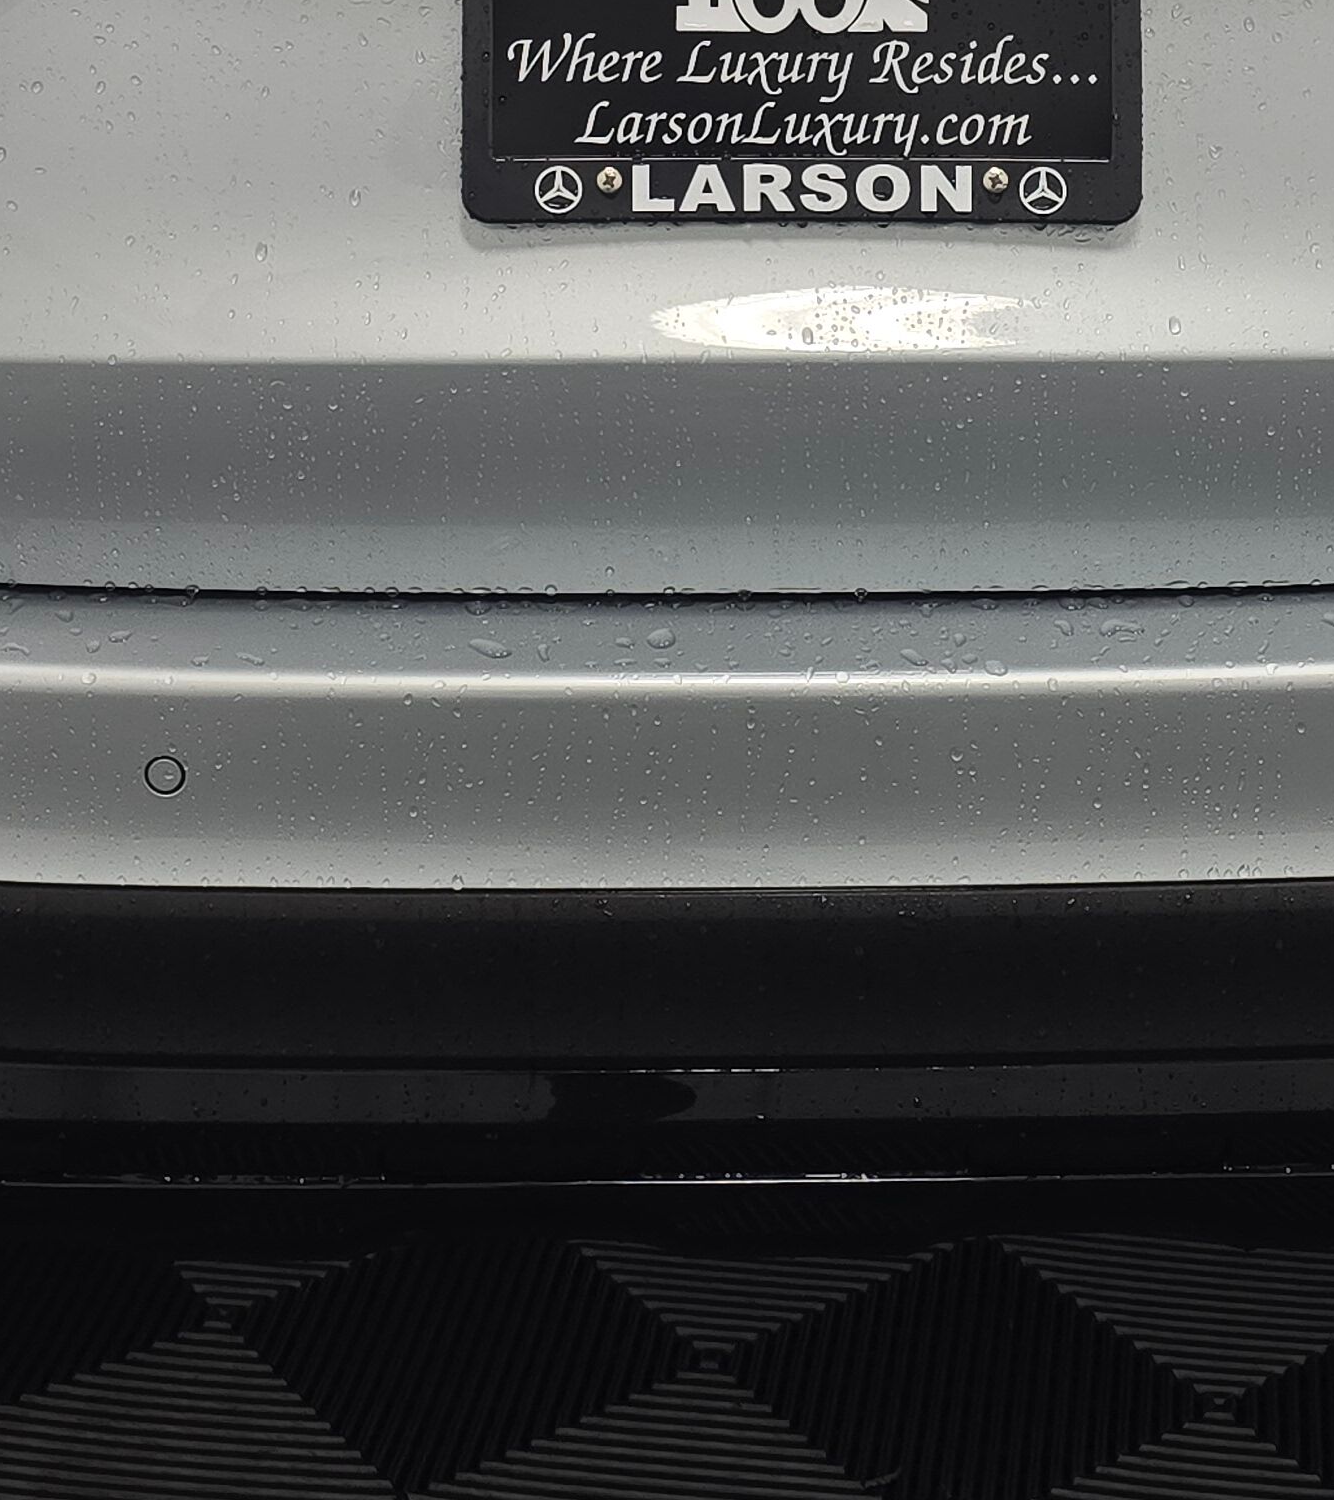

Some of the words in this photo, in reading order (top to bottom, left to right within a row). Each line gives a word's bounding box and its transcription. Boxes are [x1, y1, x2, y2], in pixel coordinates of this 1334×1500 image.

[507, 32, 663, 83] Where
[676, 40, 854, 103] Luxury
[868, 34, 1099, 94] Resides...
[573, 100, 1032, 157] LarsonLuxury.com
[631, 162, 973, 213] LARSON
